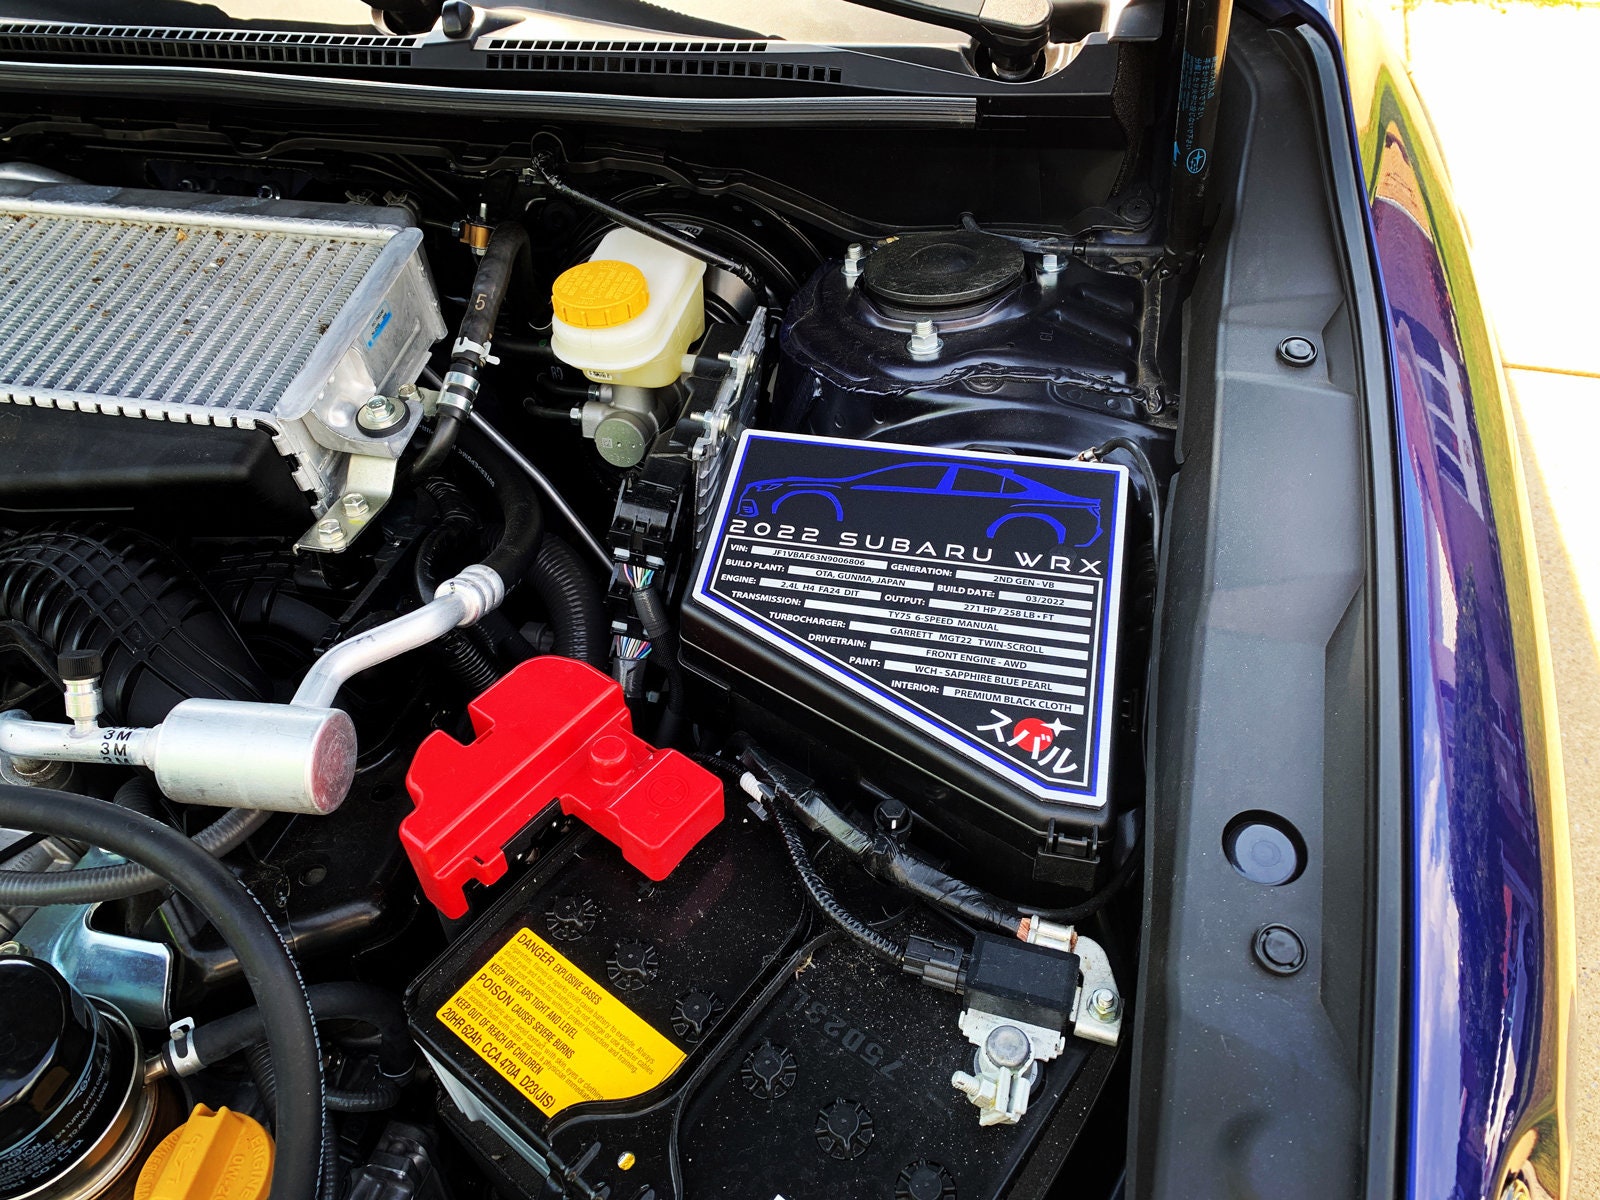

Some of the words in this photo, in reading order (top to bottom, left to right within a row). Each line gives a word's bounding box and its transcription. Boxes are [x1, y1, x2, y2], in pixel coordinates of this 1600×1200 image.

[475, 293, 487, 310] 5
[729, 519, 820, 542] 2022
[839, 531, 993, 562] SUBARU
[1015, 551, 1101, 575] WRX
[730, 543, 749, 553] VIN:
[721, 573, 757, 585] ENGINE:
[780, 581, 799, 591] 2.4L
[802, 584, 815, 592] H4
[818, 586, 841, 595] FA24
[844, 588, 861, 598] DIT
[725, 558, 752, 568] BUILD
[753, 561, 785, 573] PLANT:
[815, 569, 836, 579] OTA,
[837, 572, 875, 584] GUNMA,
[876, 577, 906, 587] JAPAN
[890, 563, 953, 577] GENERATION:
[993, 575, 1013, 584] 2ND
[1015, 578, 1035, 587] GEN
[1042, 580, 1055, 589] VB
[731, 590, 802, 607] TRANSMISSION:
[888, 610, 911, 620] TY75
[915, 614, 954, 626] 6-SPEED
[957, 619, 1000, 632] MANUAL
[884, 593, 926, 606] OUTPUT:
[963, 603, 980, 613] 271
[983, 606, 997, 615] HP
[1003, 608, 1021, 618] 258
[1023, 610, 1035, 620] LB
[1043, 613, 1055, 622] FT
[937, 584, 965, 595] BUILD
[967, 587, 995, 598] DATE:
[1025, 595, 1065, 607] 03/2022
[768, 611, 847, 629] TURBOCHARGER:
[890, 627, 934, 640] GARRETT
[938, 633, 973, 645] MGT22
[978, 638, 1045, 654] TWIN-SCROLL
[807, 633, 867, 649] DRIVETRAIN:
[926, 649, 959, 661] FRONT
[960, 653, 997, 666] ENGINE
[1003, 660, 1028, 670] AWD
[848, 656, 881, 668] PAINT:
[914, 665, 937, 675] WCH
[944, 668, 993, 683] SAPPHIRE
[994, 675, 1020, 687] BLUE
[1021, 679, 1053, 691] PEARL
[891, 679, 940, 694] INTERIOR:
[954, 688, 1002, 703] PREMIUM
[1004, 696, 1037, 708] BLACK
[1038, 700, 1073, 713] CLOTH
[976, 708, 1078, 774] スバル
[517, 933, 555, 967] DANGER
[552, 963, 584, 990] EXPLOSIVE
[581, 986, 602, 1005] GASES
[476, 973, 515, 1007] POISON
[511, 1003, 536, 1026] CAUSES
[532, 1021, 556, 1043] SEVERE
[552, 1038, 575, 1059] BURNS
[488, 962, 506, 976] KEEP
[502, 973, 520, 989] VENT
[515, 985, 534, 1001] CAPS
[530, 996, 551, 1014] TIGHT
[546, 1011, 562, 1025] AND
[558, 1020, 578, 1040] LEVEL
[454, 996, 472, 1011] KEEP
[467, 1007, 483, 1021] OUT
[478, 1017, 491, 1028] OF
[486, 1024, 509, 1044] REACH
[504, 1040, 517, 1050] OF
[512, 1046, 544, 1075] CHILDREN
[441, 1007, 466, 1030] 20HR
[461, 1024, 482, 1046] 62Ah
[481, 1042, 502, 1062] CCA
[499, 1058, 521, 1079] 470A
[519, 1075, 556, 1109] D23(JIS)
[0, 1142, 42, 1168] AUTION
[240, 1135, 263, 1199] ENGINE
